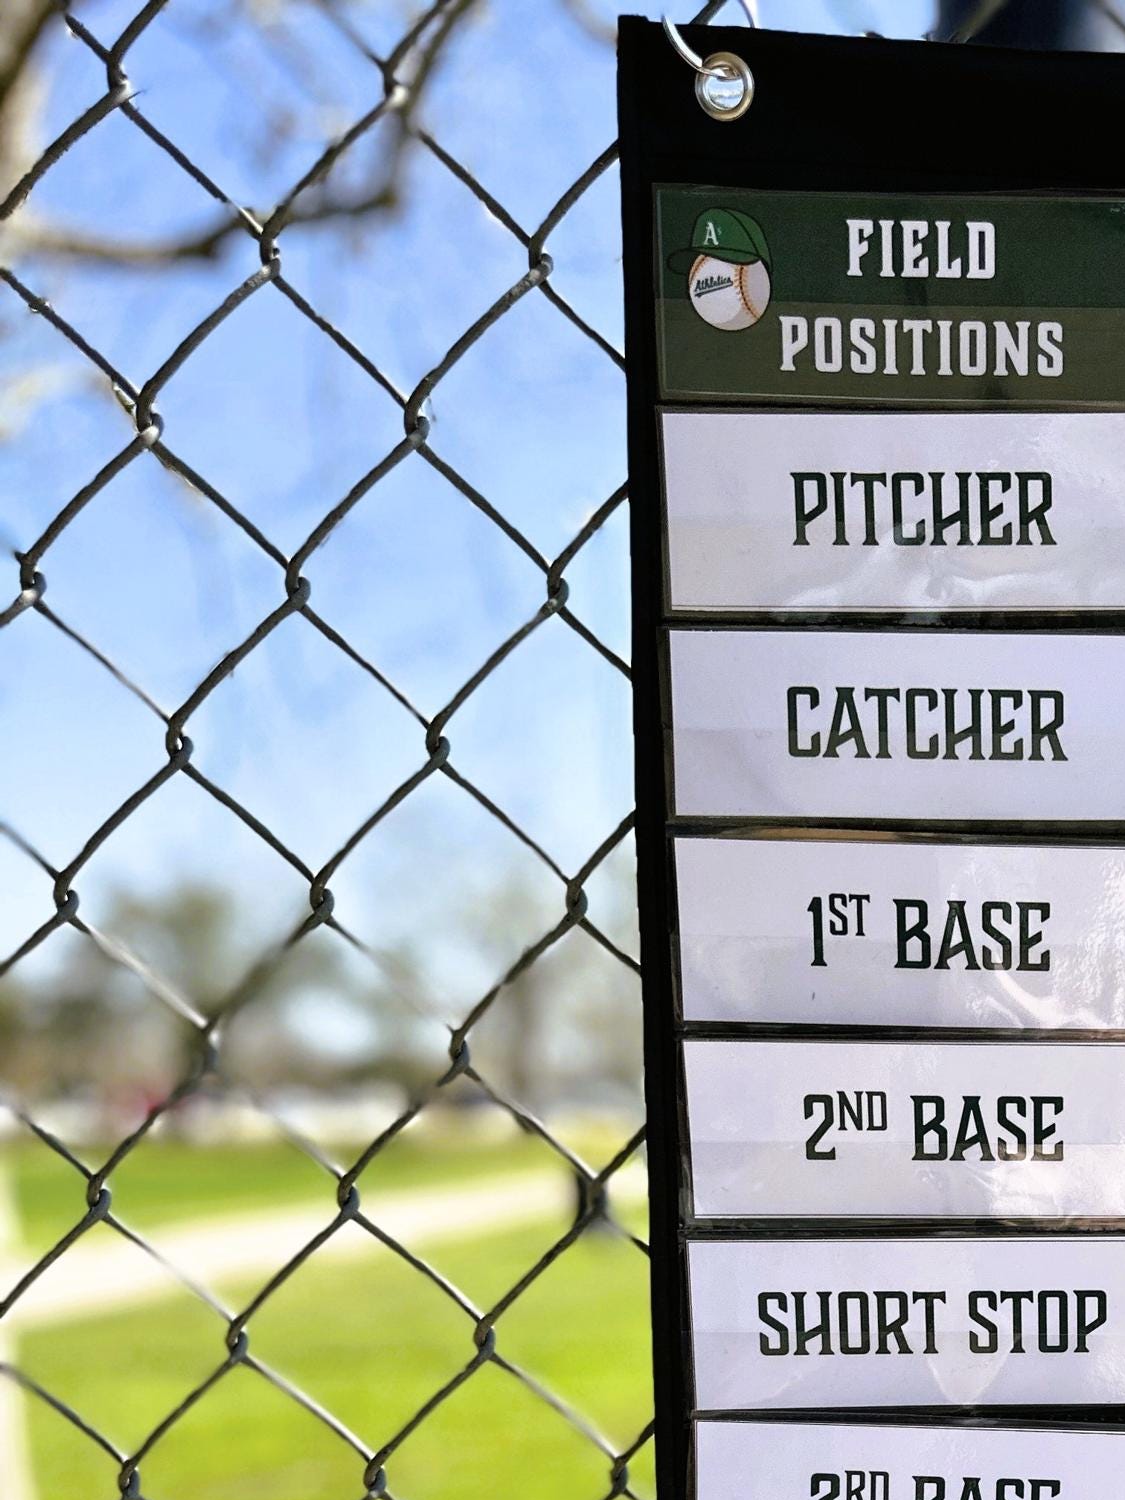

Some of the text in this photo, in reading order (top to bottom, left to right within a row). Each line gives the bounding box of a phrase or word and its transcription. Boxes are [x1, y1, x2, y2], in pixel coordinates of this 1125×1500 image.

[846, 219, 995, 279] FIELD
[779, 316, 1064, 376] POSITIONS
[790, 471, 1057, 546] PITCHER
[787, 686, 1068, 761] CATCHER
[807, 893, 1051, 971] 1ST BASE
[804, 1091, 1064, 1161] 2ND BASE
[758, 1289, 1107, 1356] SHORT STOP
